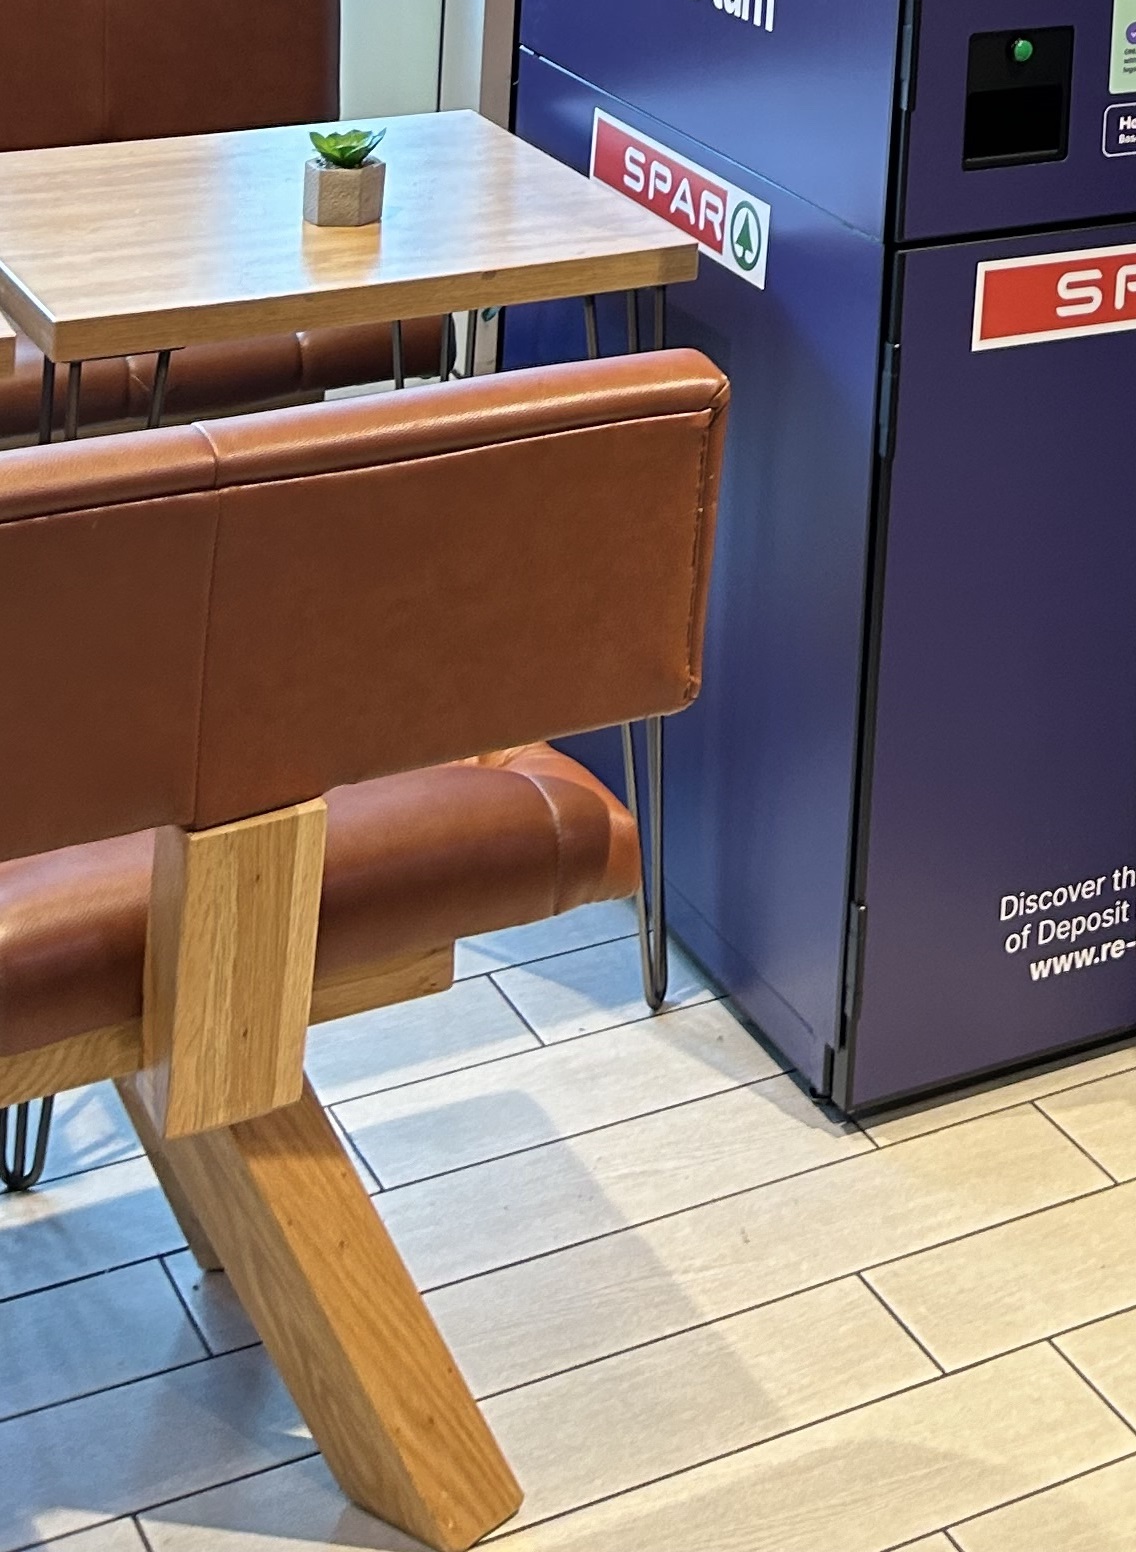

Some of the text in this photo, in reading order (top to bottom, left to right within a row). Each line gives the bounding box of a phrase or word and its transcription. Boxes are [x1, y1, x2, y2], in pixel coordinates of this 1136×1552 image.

[623, 146, 725, 243] SPAR
[999, 875, 1107, 922] Discover
[1004, 922, 1032, 955] of
[1038, 900, 1130, 946] Deposit
